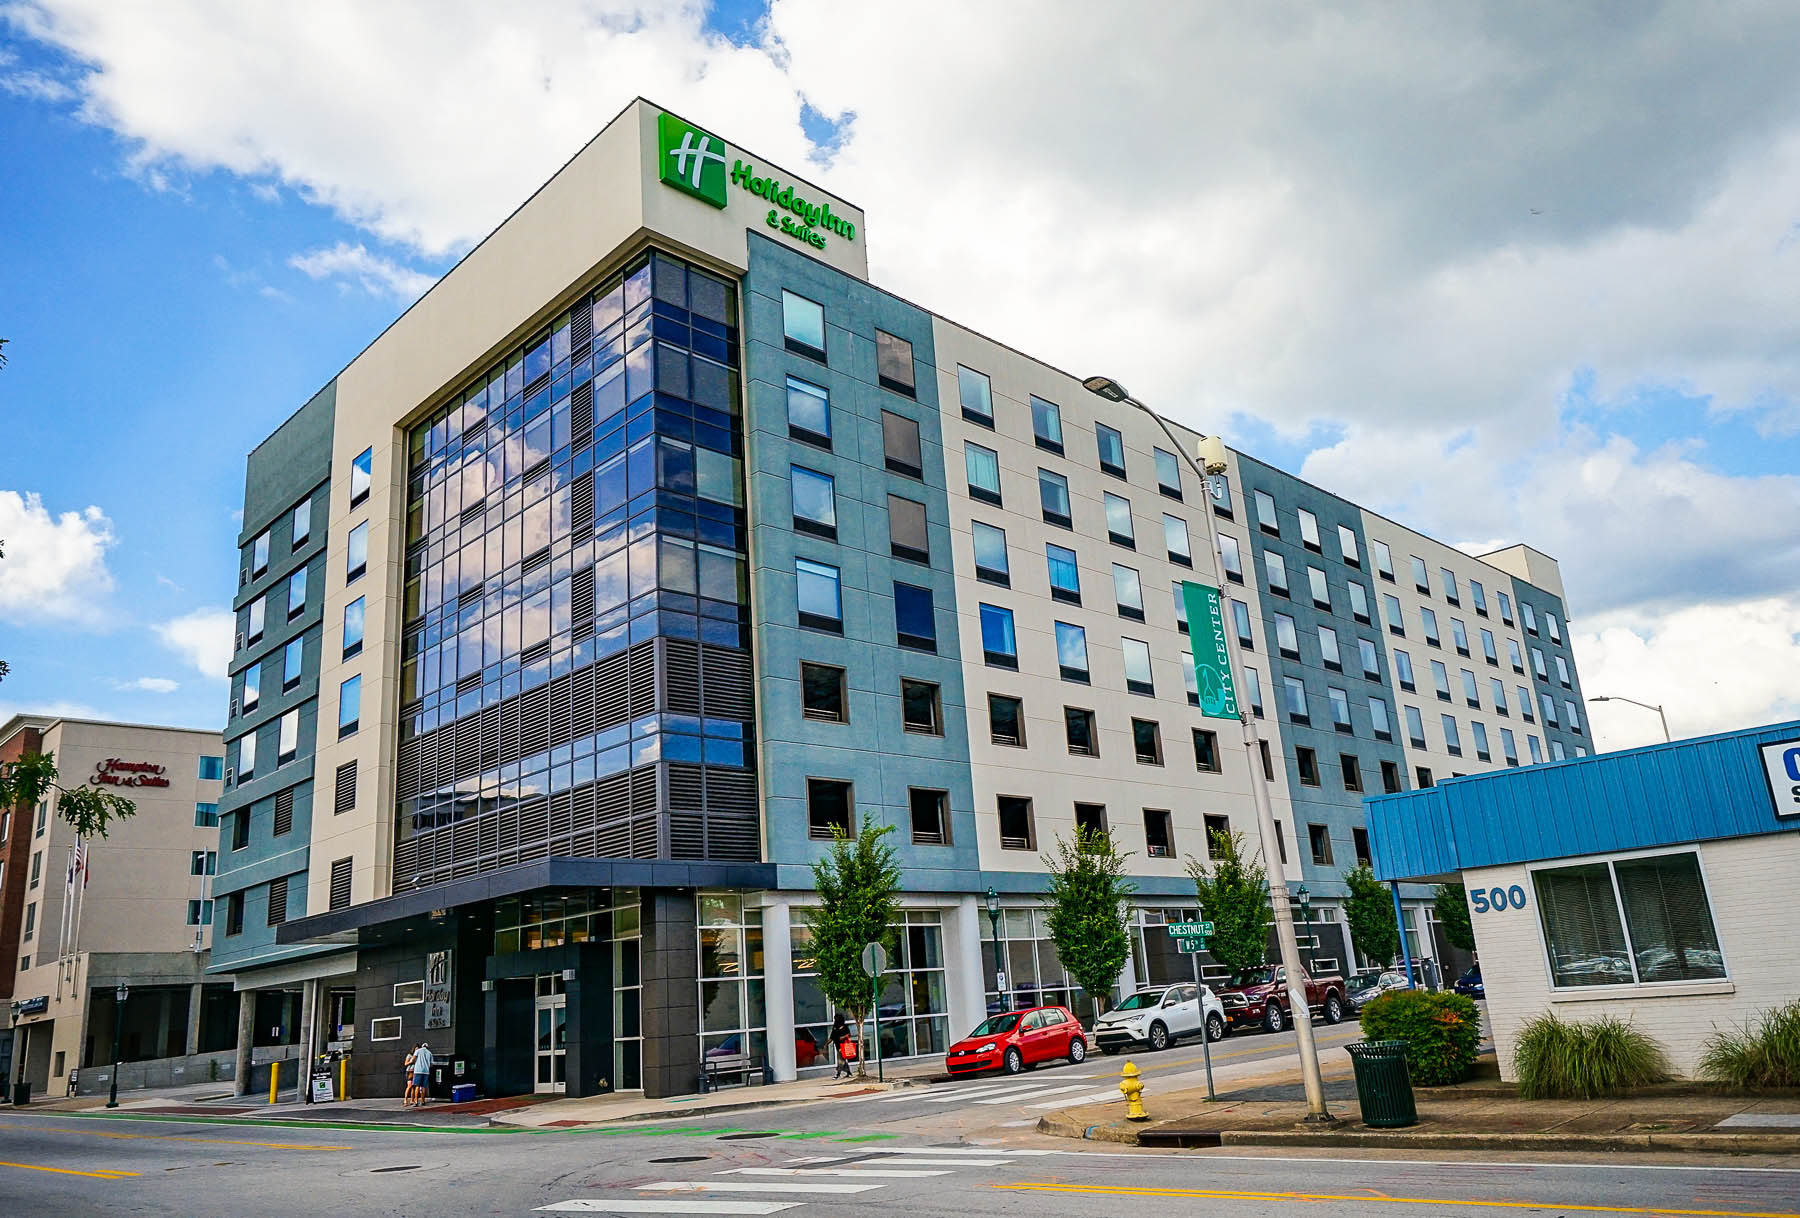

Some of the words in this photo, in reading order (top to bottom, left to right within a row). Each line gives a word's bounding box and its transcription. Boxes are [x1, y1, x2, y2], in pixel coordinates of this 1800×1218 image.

[766, 209, 779, 230] &
[780, 216, 827, 250] Suites
[1207, 593, 1227, 666] CENTER
[1221, 670, 1236, 714] CITY
[96, 758, 166, 775] Hampton
[133, 774, 170, 788] Suites
[1470, 884, 1526, 913] 500
[1168, 924, 1205, 935] CHESTNUT
